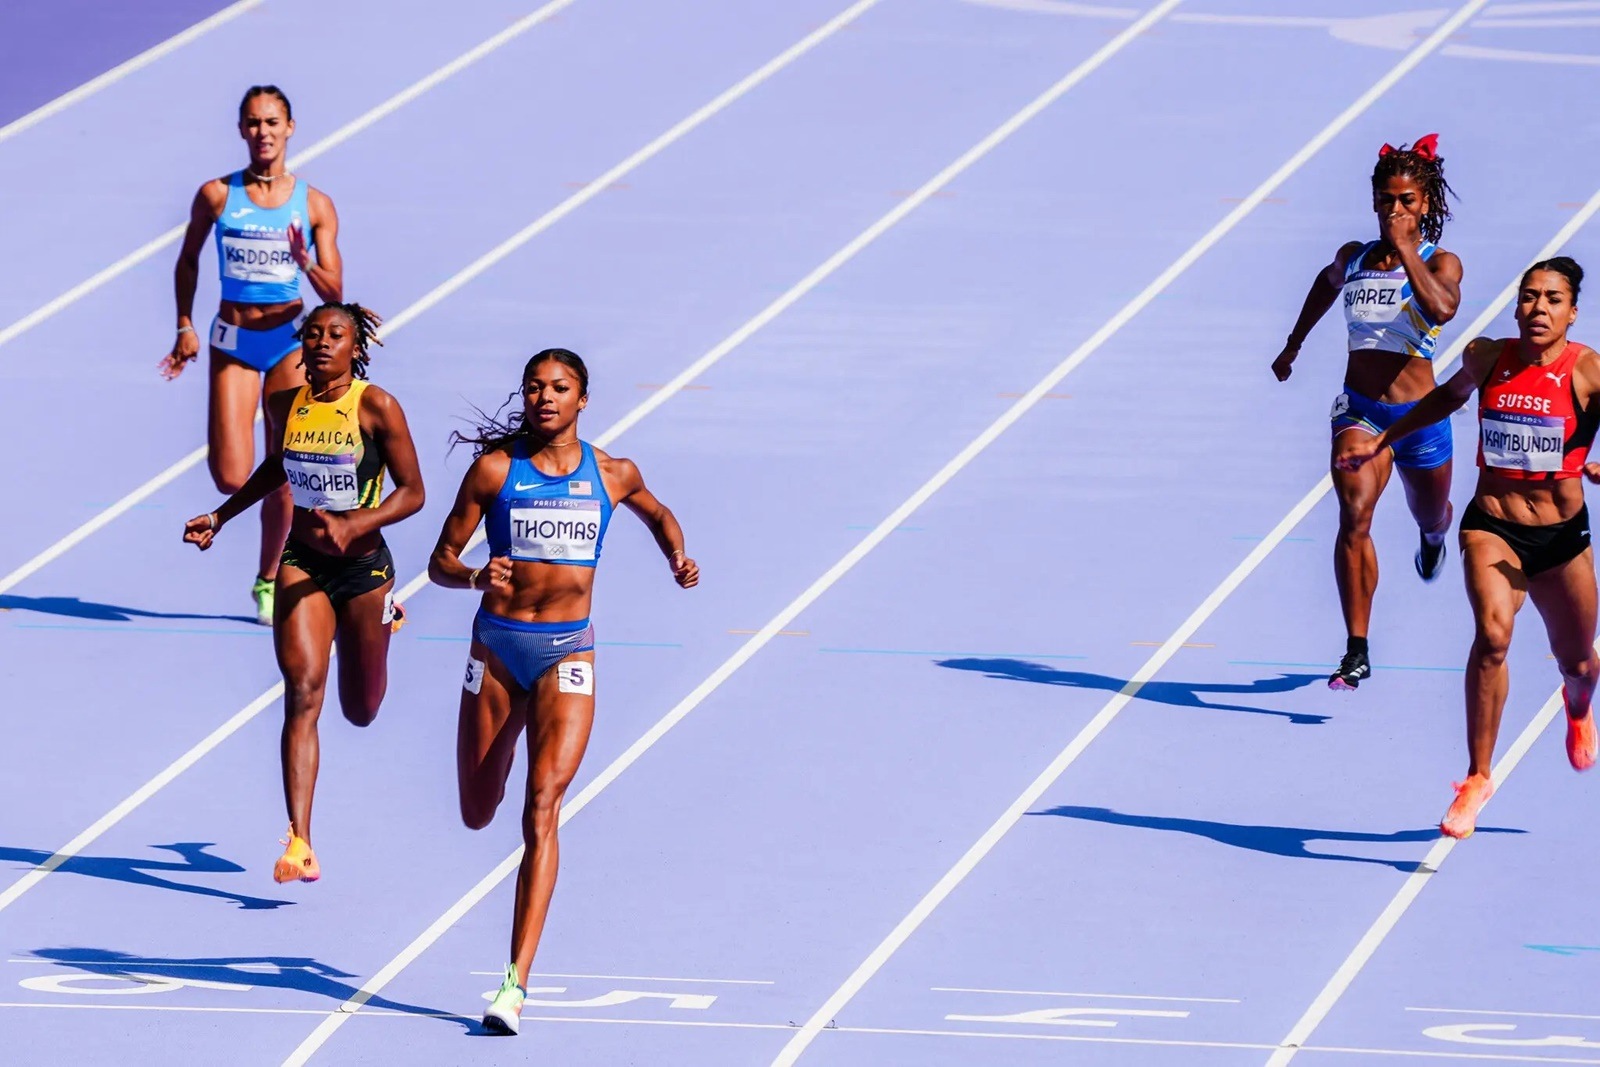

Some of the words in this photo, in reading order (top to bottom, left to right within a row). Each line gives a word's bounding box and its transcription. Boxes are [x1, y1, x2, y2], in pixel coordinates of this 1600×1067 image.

[225, 245, 295, 266] KADDAR
[1344, 288, 1396, 308] SUAREZ
[218, 325, 228, 343] 7
[1500, 413, 1521, 422] PARIS
[1522, 416, 1542, 424] 2024
[286, 430, 355, 447] JAMAICA
[1484, 429, 1561, 453] KAMBUNDJI
[296, 453, 315, 461] PARIS
[286, 468, 355, 492] BURGHER
[533, 499, 557, 507] PARIS
[558, 500, 579, 508] 2024
[513, 519, 598, 540] THOMAS
[465, 662, 475, 684] 5
[569, 667, 585, 687] 5
[18, 973, 253, 995] 6
[481, 986, 718, 1009] 5
